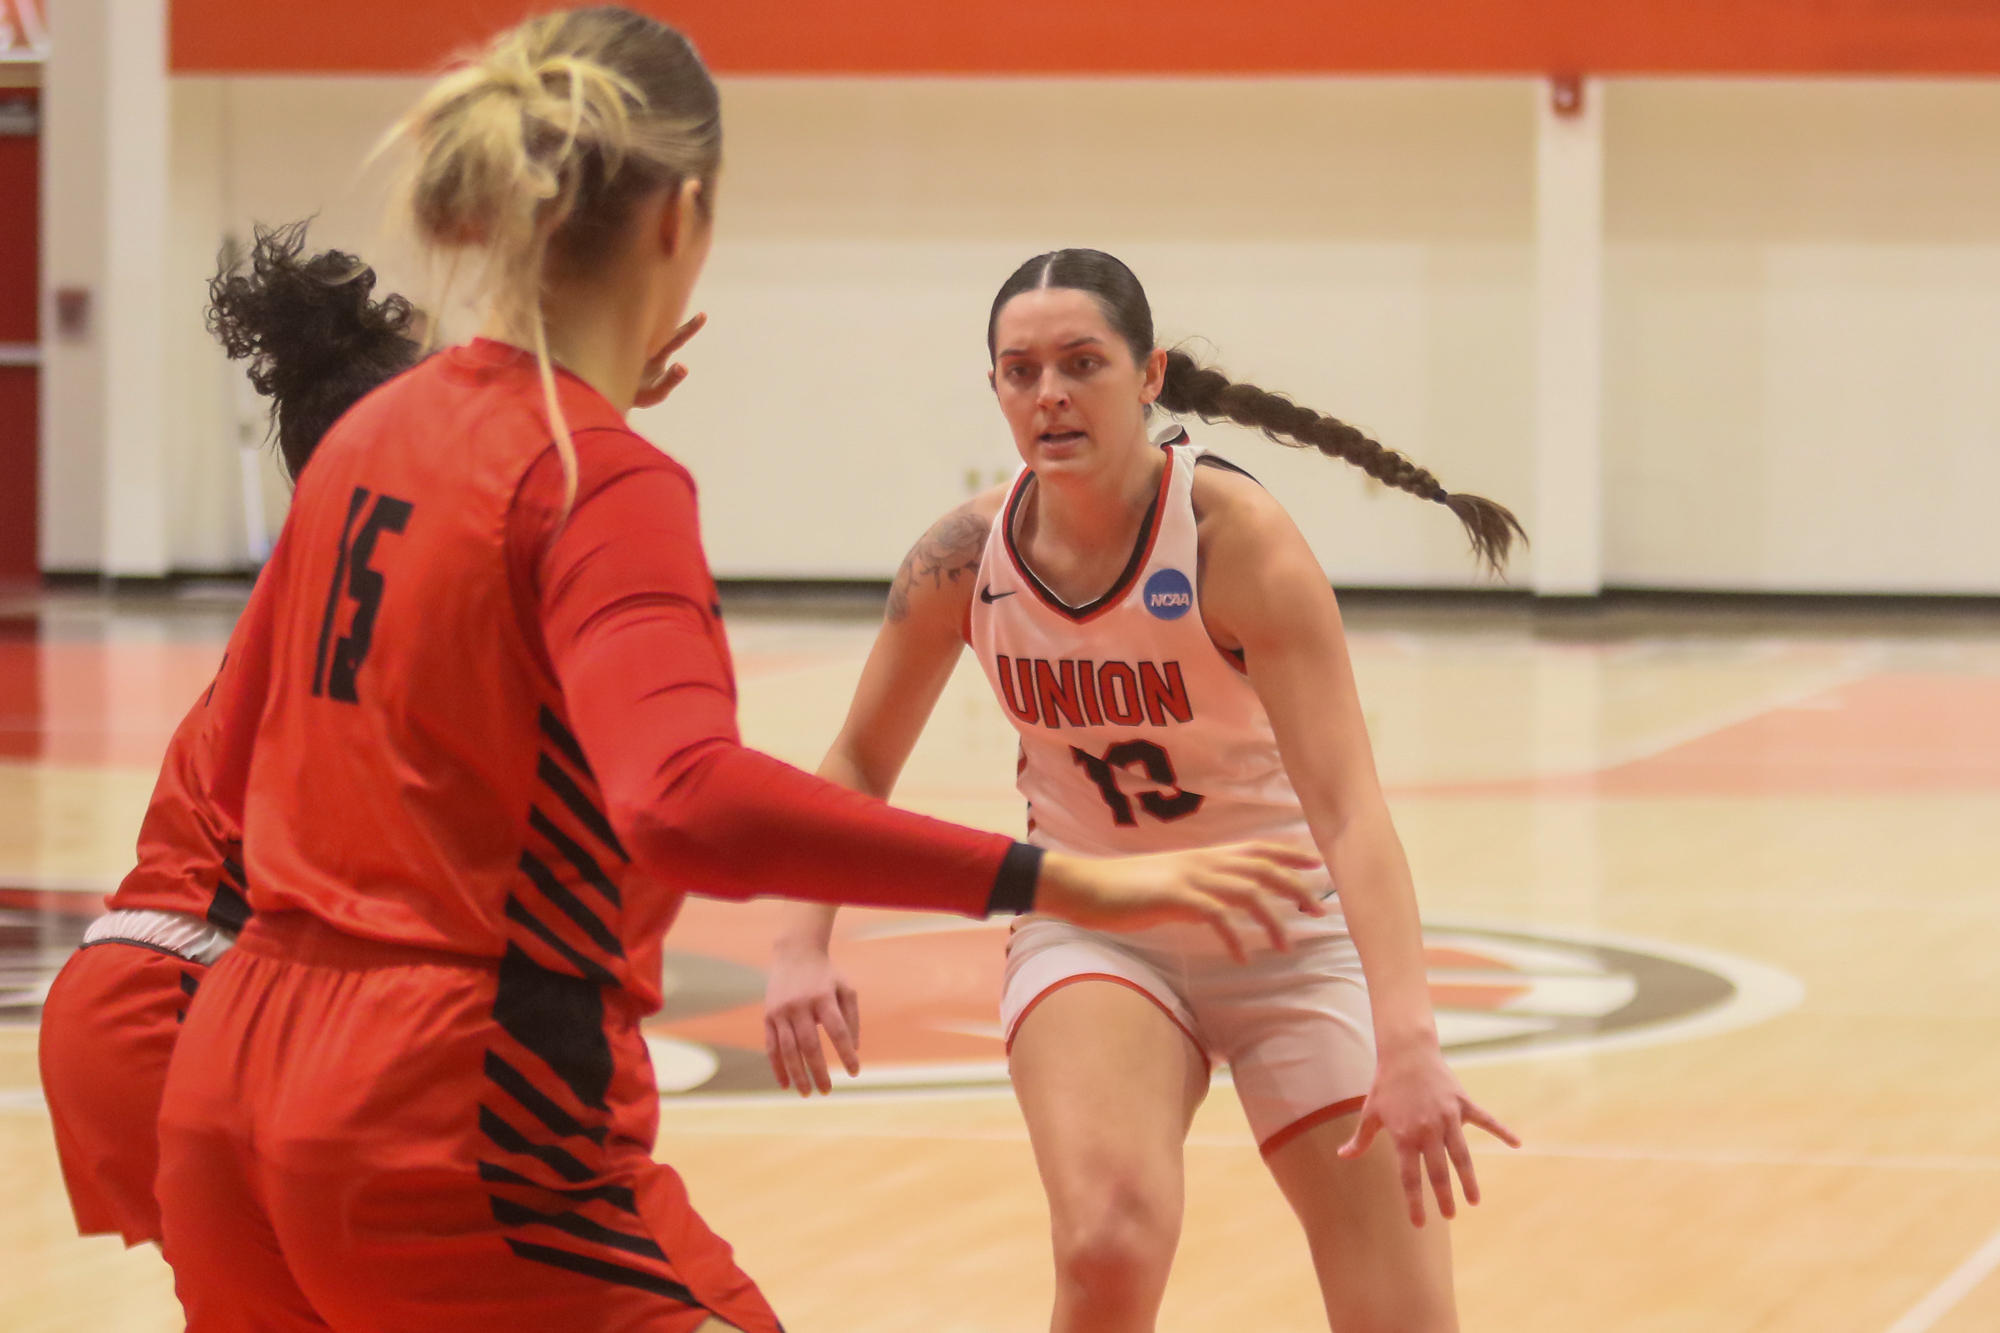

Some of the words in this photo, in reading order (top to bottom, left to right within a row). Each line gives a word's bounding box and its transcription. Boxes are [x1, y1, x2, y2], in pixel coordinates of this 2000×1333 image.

[312, 486, 414, 706] 15
[1151, 593, 1190, 607] NCAA
[996, 655, 1194, 729] UNION
[1068, 738, 1205, 828] 13
